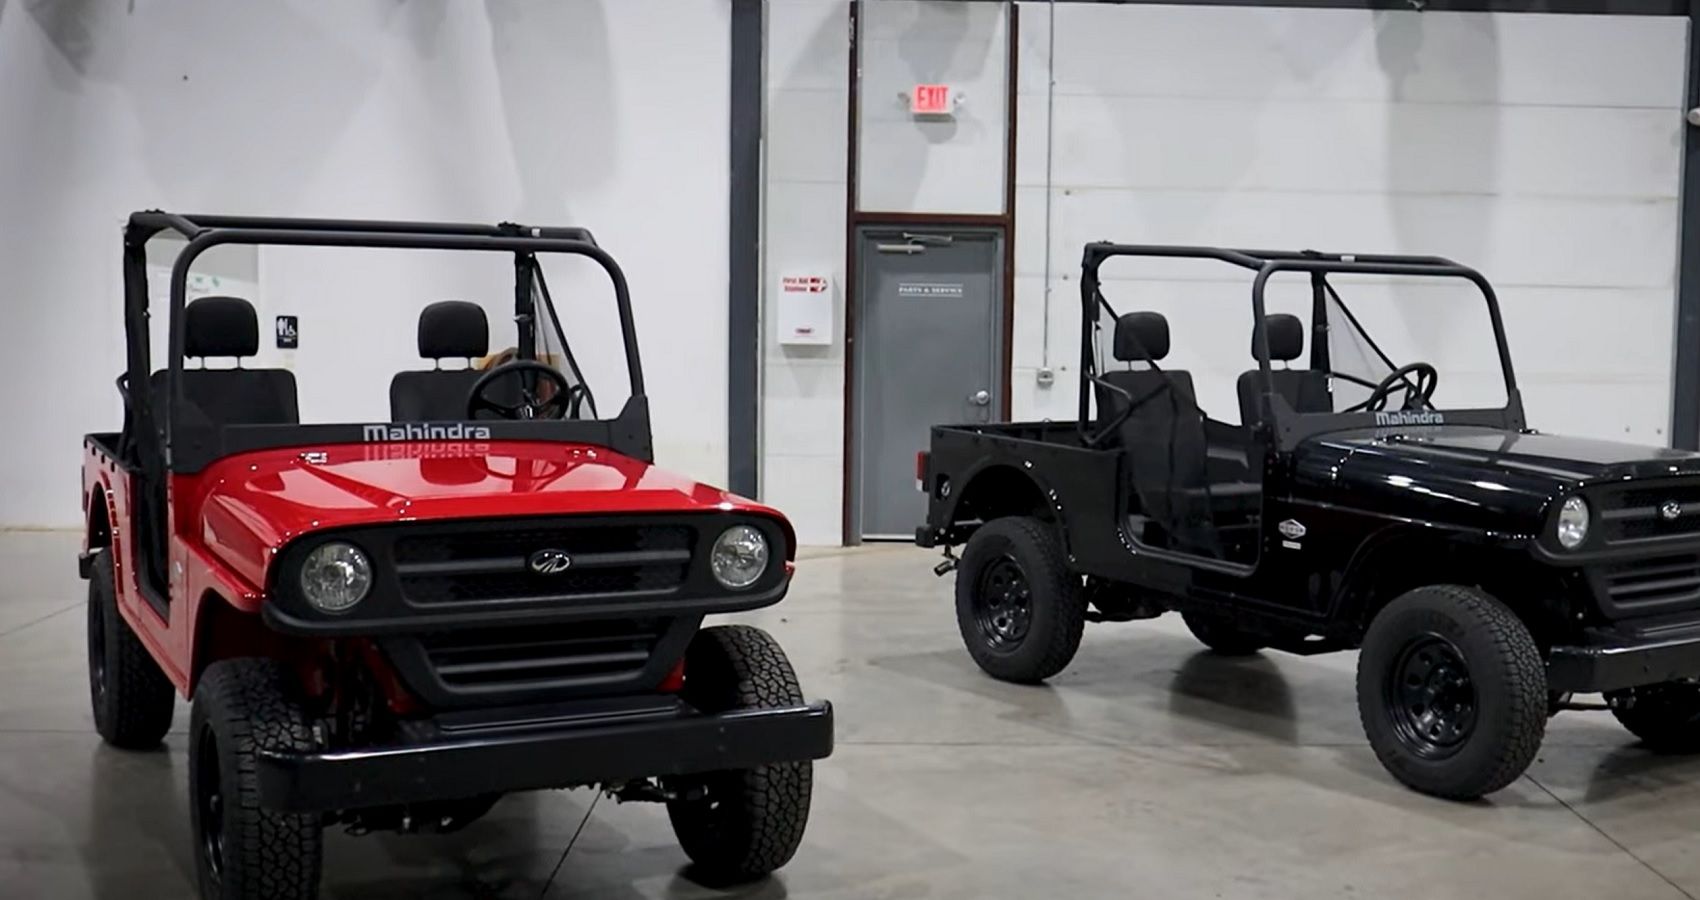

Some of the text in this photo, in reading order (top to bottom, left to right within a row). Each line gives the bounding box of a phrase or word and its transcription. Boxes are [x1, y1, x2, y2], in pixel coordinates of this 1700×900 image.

[917, 86, 949, 109] EXIT
[899, 286, 922, 294] PARTS
[924, 286, 930, 294] &
[1375, 411, 1445, 426] Mahindra
[363, 422, 491, 442] Mahindra
